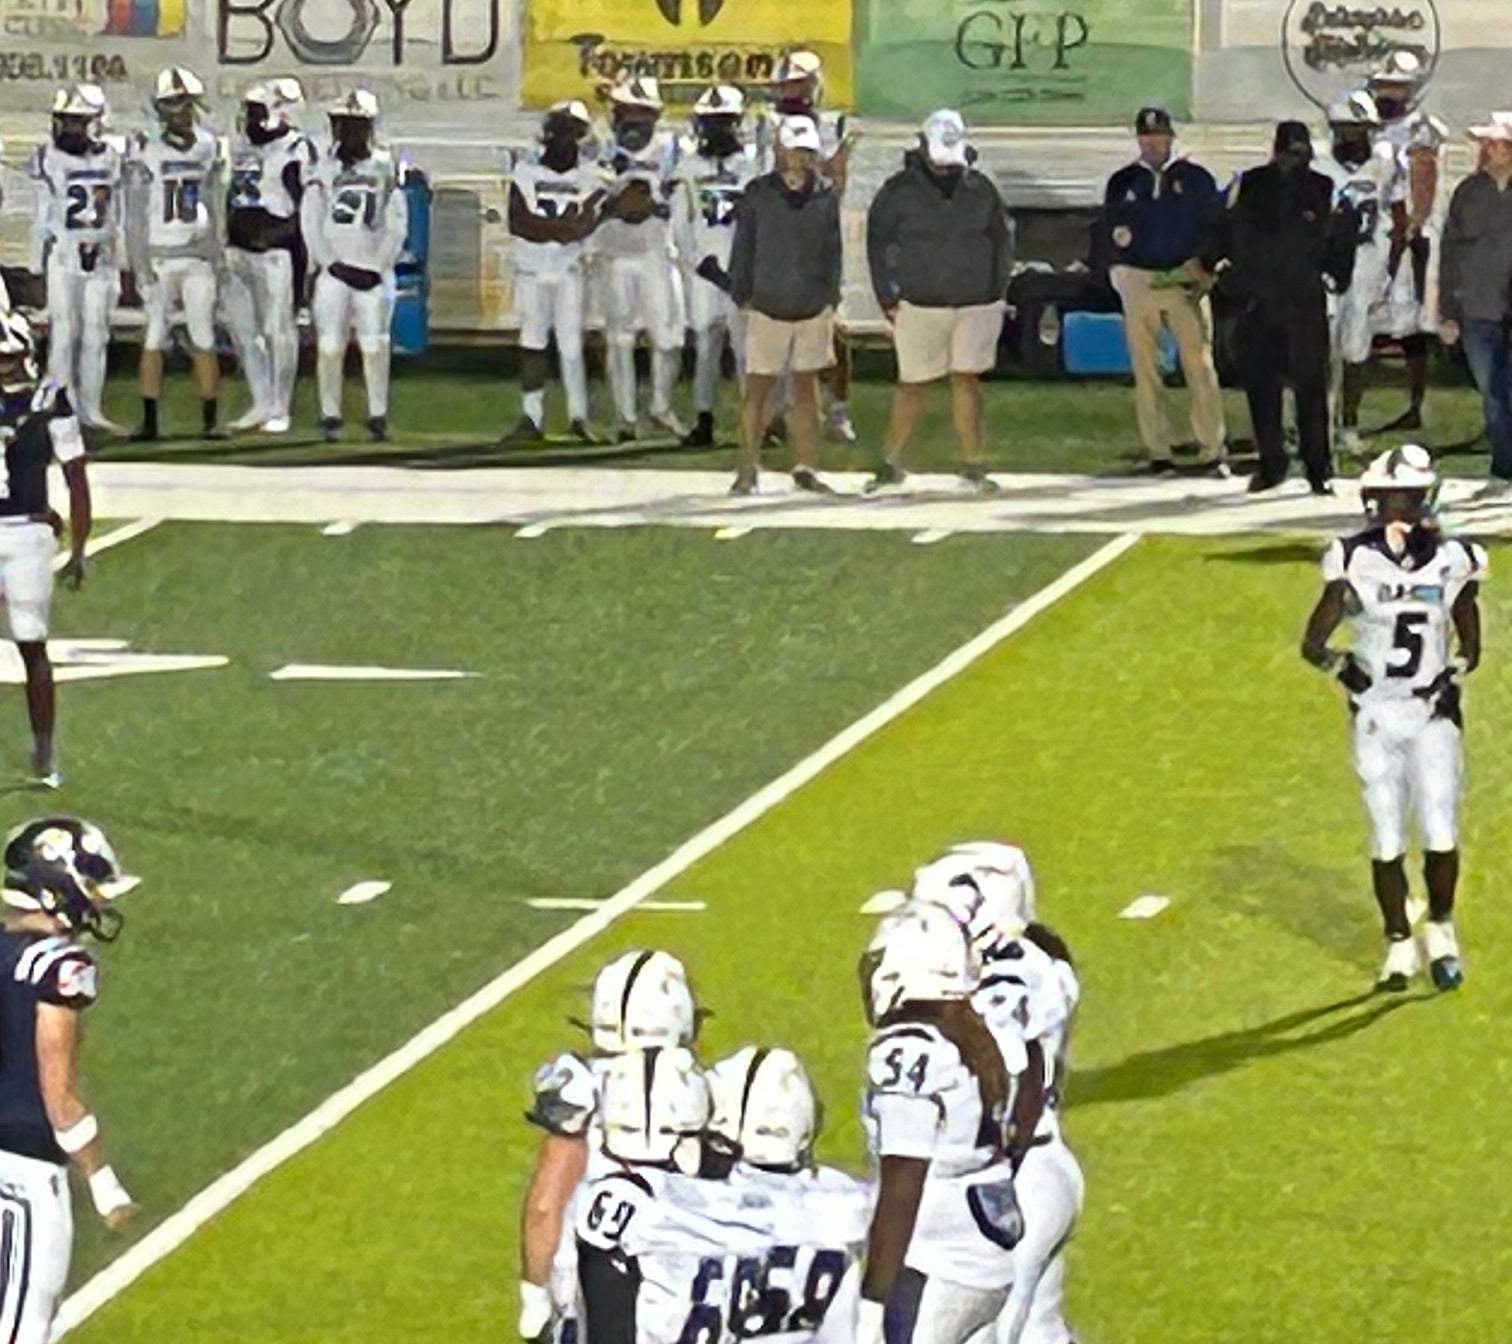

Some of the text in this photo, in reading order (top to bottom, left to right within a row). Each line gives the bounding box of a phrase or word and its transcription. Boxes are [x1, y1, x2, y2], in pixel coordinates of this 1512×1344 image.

[1387, 611, 1428, 678] 5
[883, 1048, 929, 1093] 54
[588, 1189, 636, 1241] 69
